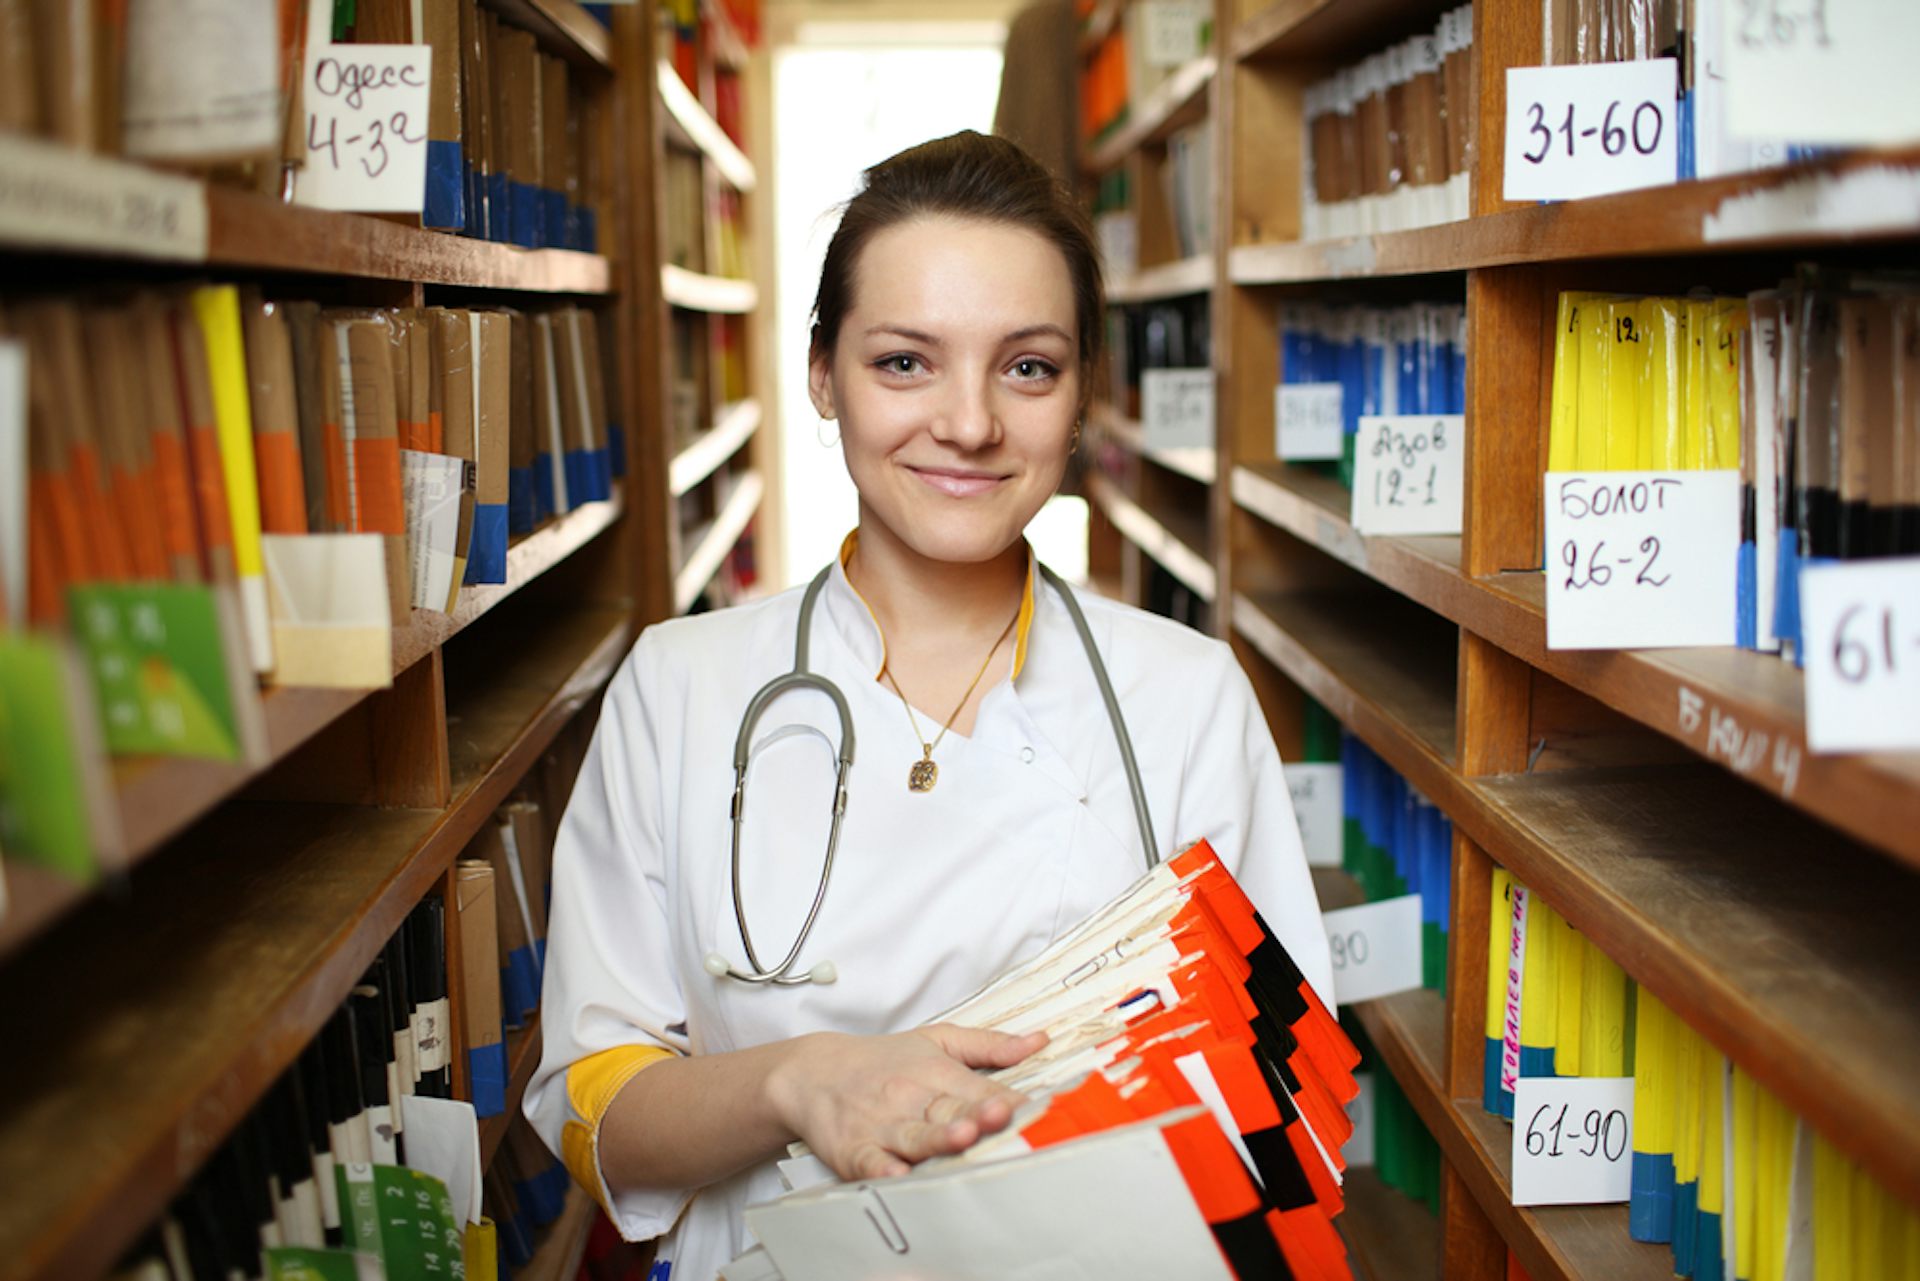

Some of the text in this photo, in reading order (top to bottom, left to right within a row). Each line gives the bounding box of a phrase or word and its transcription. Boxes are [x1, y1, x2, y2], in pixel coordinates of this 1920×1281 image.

[315, 58, 426, 110] Одесс
[1522, 100, 1663, 164] 31-60
[1616, 316, 1639, 343] 12
[1374, 463, 1438, 507] 12-1
[1560, 477, 1683, 519] БОЛОТ
[1561, 535, 1672, 591] 26-2
[1525, 1103, 1628, 1163] 61-90
[386, 1186, 408, 1227] 1 2
[414, 1189, 441, 1272] 14 15 16
